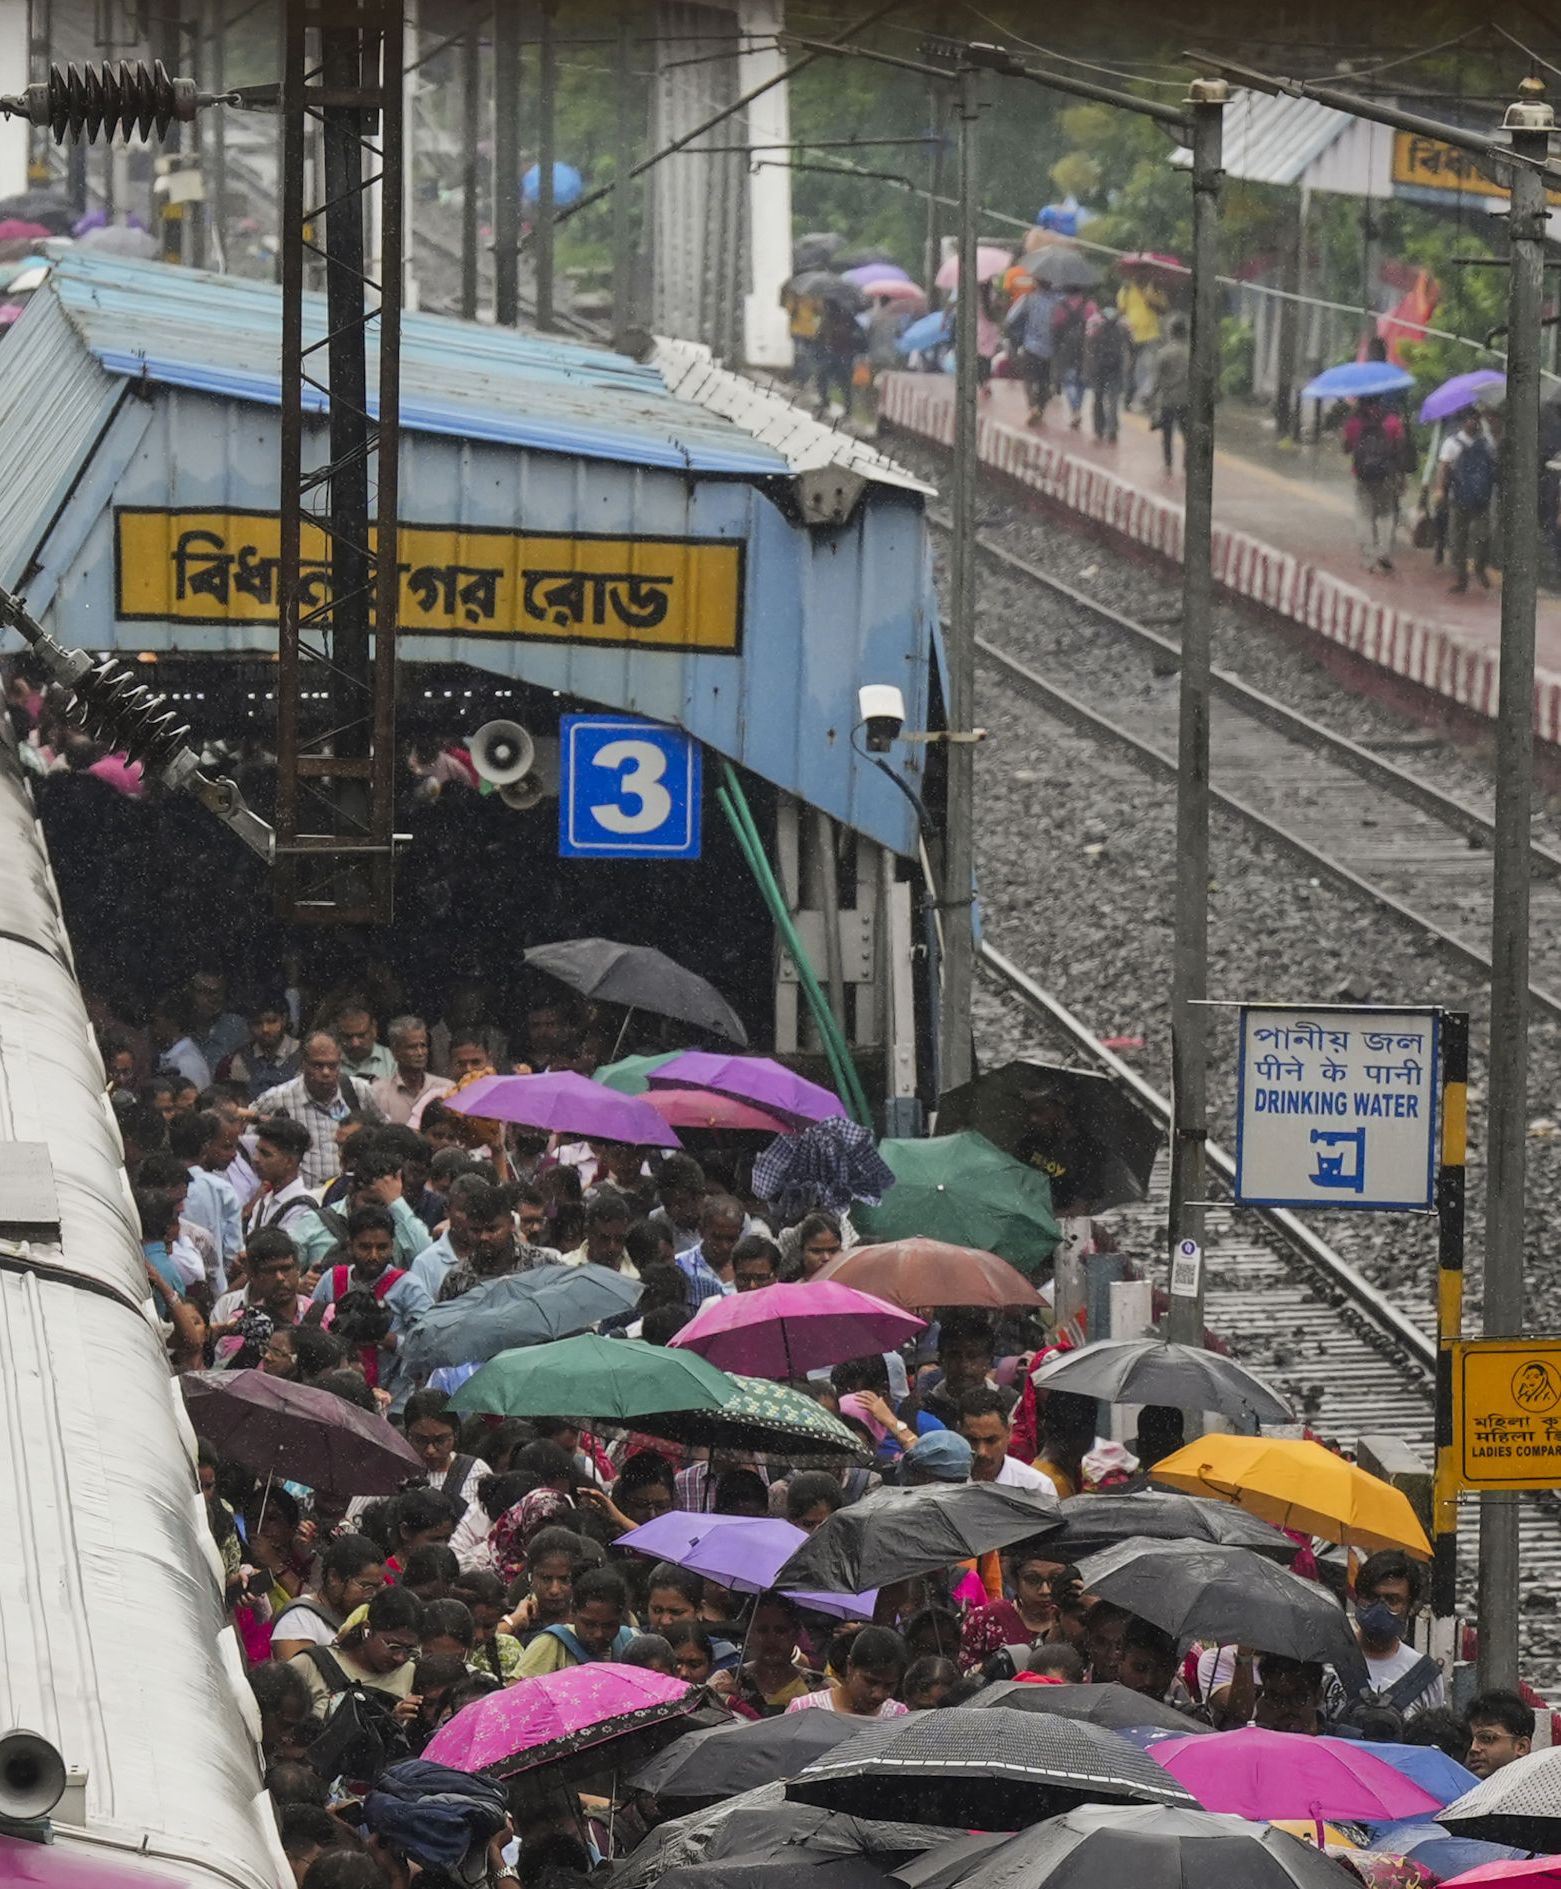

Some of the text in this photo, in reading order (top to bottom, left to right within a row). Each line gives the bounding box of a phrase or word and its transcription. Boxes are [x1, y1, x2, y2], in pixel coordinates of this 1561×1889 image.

[521, 569, 673, 629] রোড
[590, 740, 671, 834] 3
[1253, 1021, 1425, 1054] পানীয় জল
[1254, 1054, 1423, 1085] पीने के पानी
[1254, 1088, 1419, 1118] DRINKING WATER
[1474, 1427, 1536, 1443] महिला
[1472, 1446, 1512, 1457] LADIES
